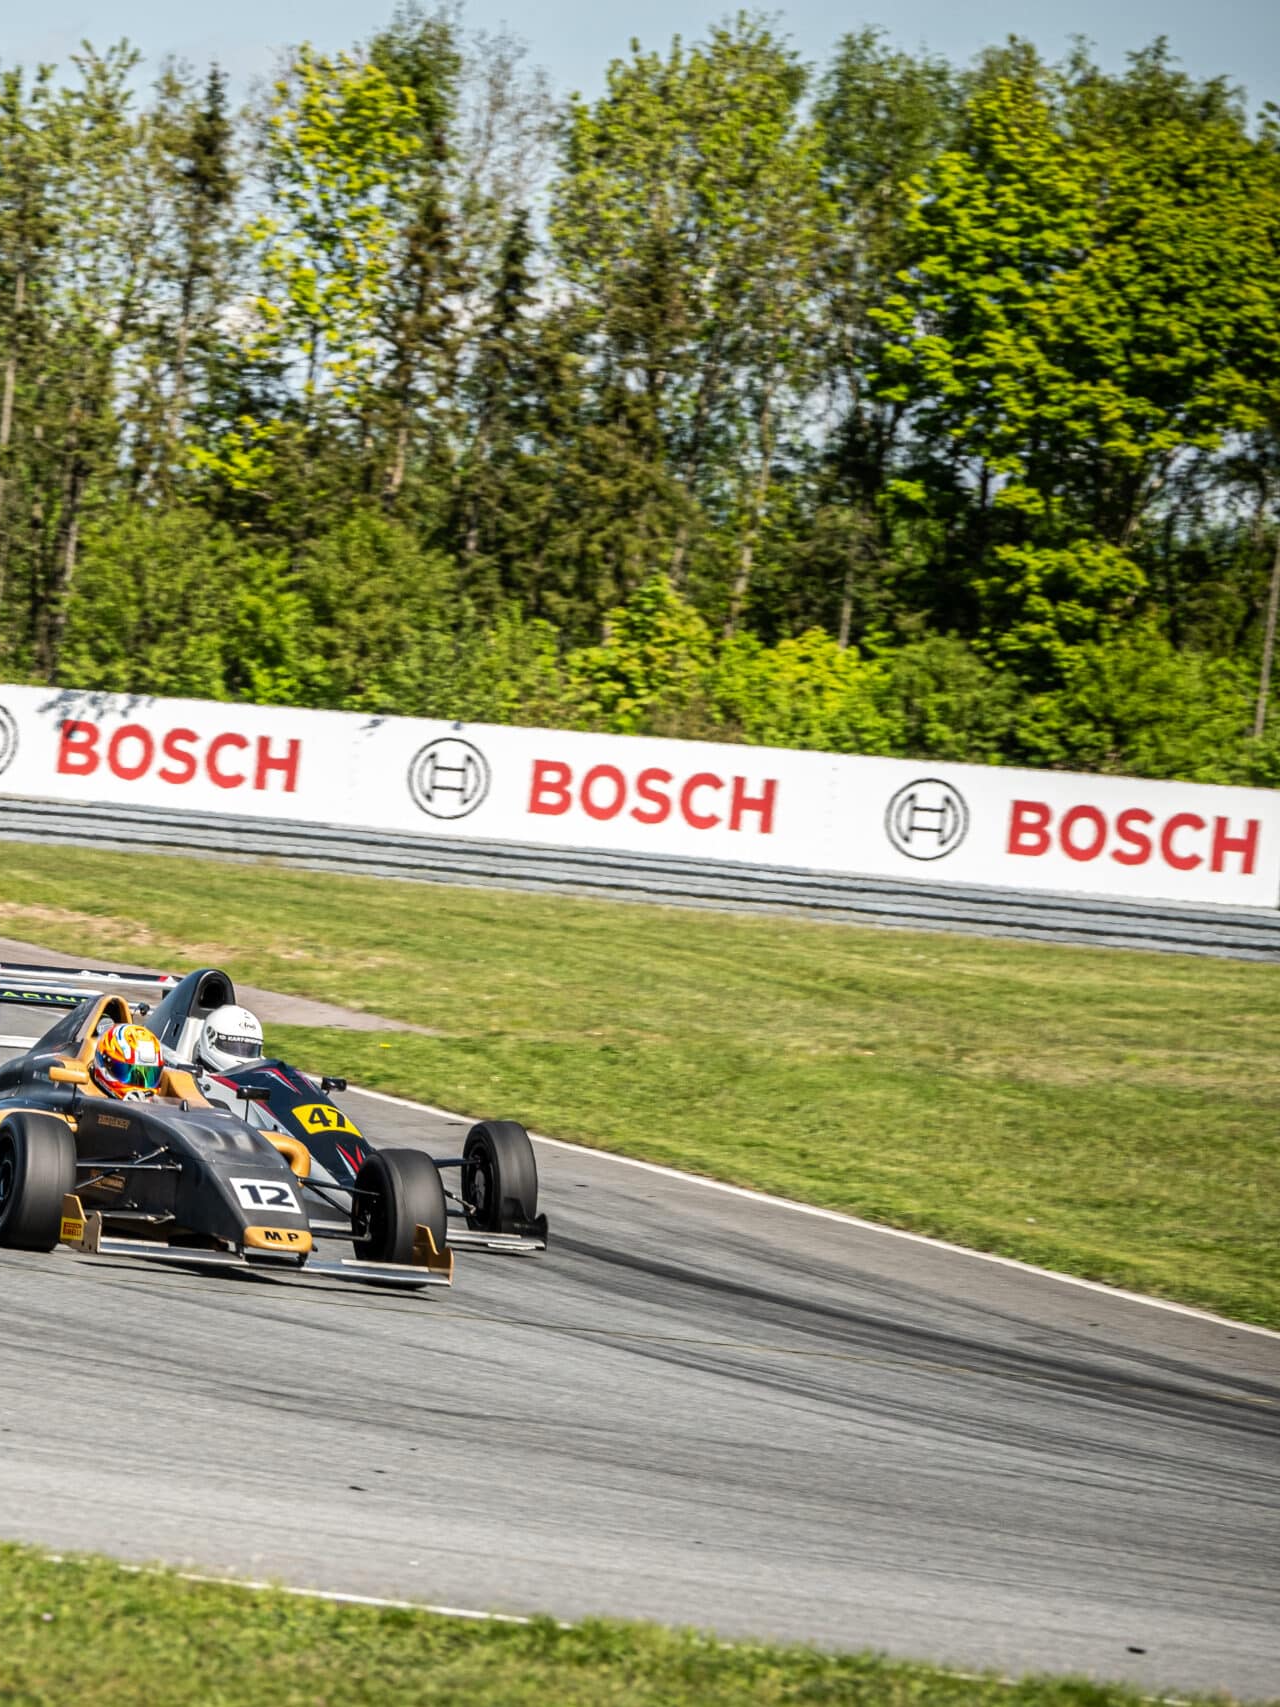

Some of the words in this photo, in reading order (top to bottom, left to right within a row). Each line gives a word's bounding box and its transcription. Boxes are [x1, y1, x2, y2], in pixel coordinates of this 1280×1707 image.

[55, 719, 302, 793] BOSCH
[527, 759, 778, 834] BOSCH
[1006, 799, 1261, 875] BOSCH
[308, 1107, 346, 1129] 47
[239, 1184, 296, 1209] 12
